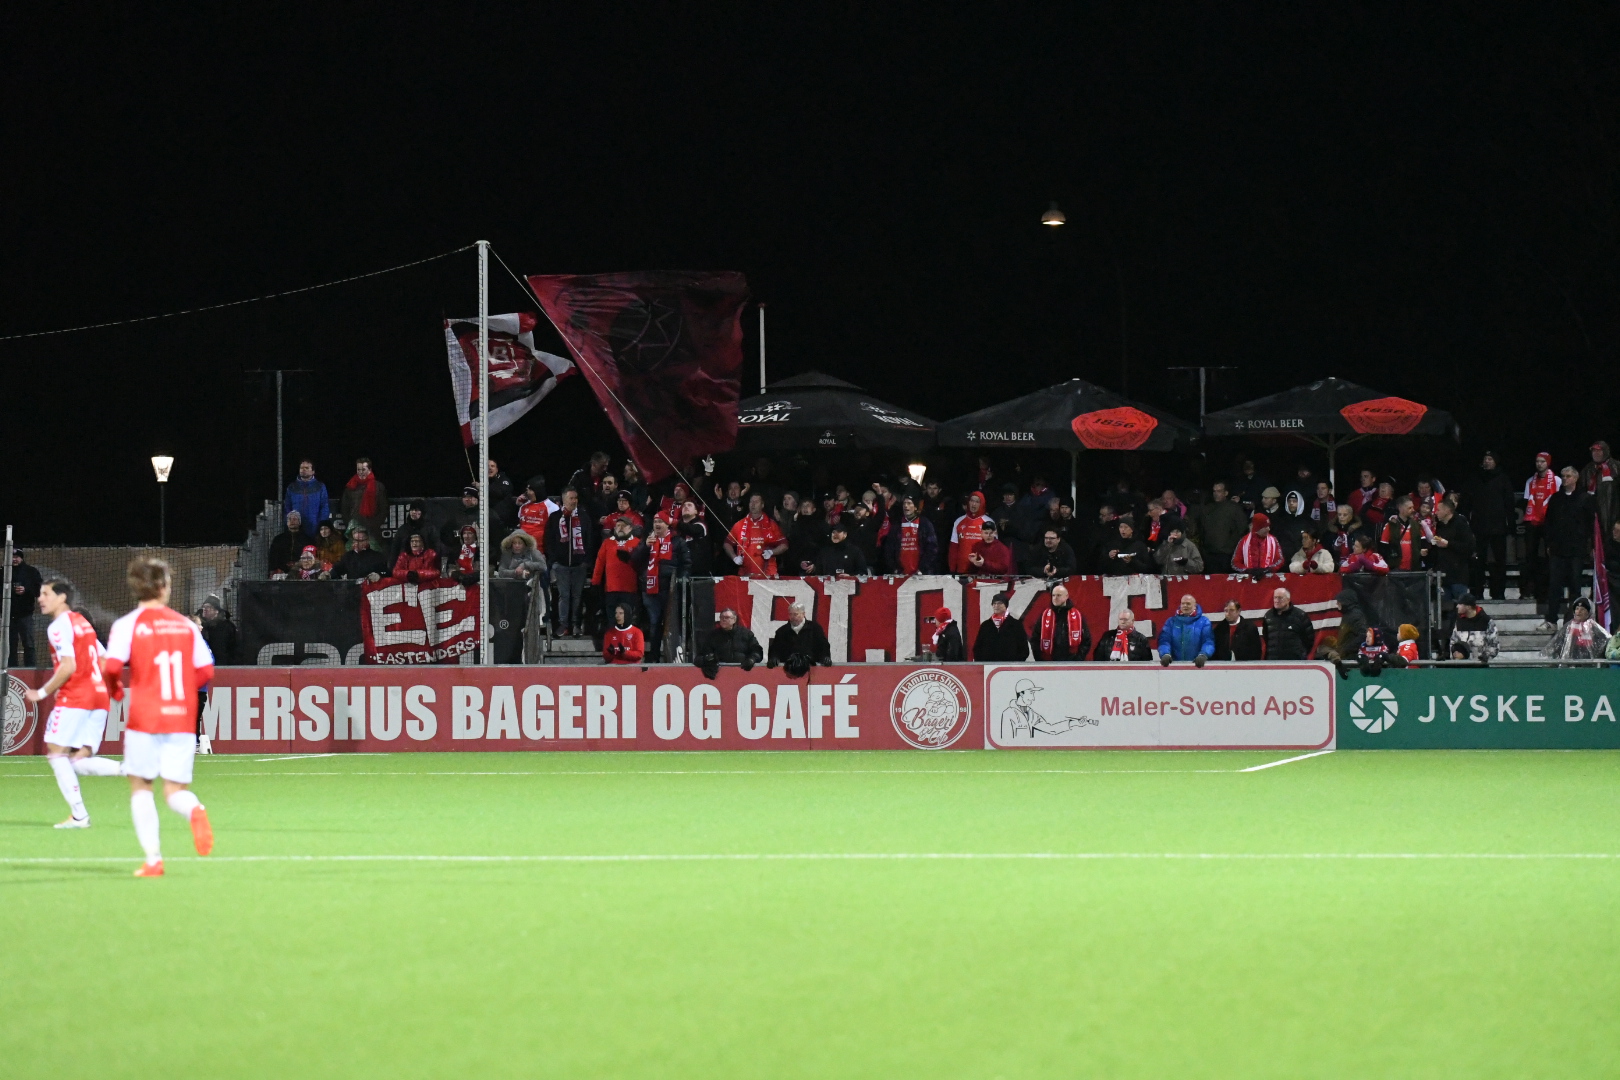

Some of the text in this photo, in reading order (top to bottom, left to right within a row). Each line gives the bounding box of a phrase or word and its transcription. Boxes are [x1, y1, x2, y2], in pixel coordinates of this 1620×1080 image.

[979, 431, 1035, 441] ROYAL BEER
[1092, 417, 1137, 429] 1856
[1248, 419, 1305, 429] ROYAL BEER
[153, 650, 186, 701] 11
[452, 684, 637, 741] BAGERI
[652, 683, 723, 741] OG
[736, 673, 860, 741] CAFÉ
[1100, 694, 1315, 720] Maler-Svend ApS
[1418, 694, 1546, 724] JYSKE
